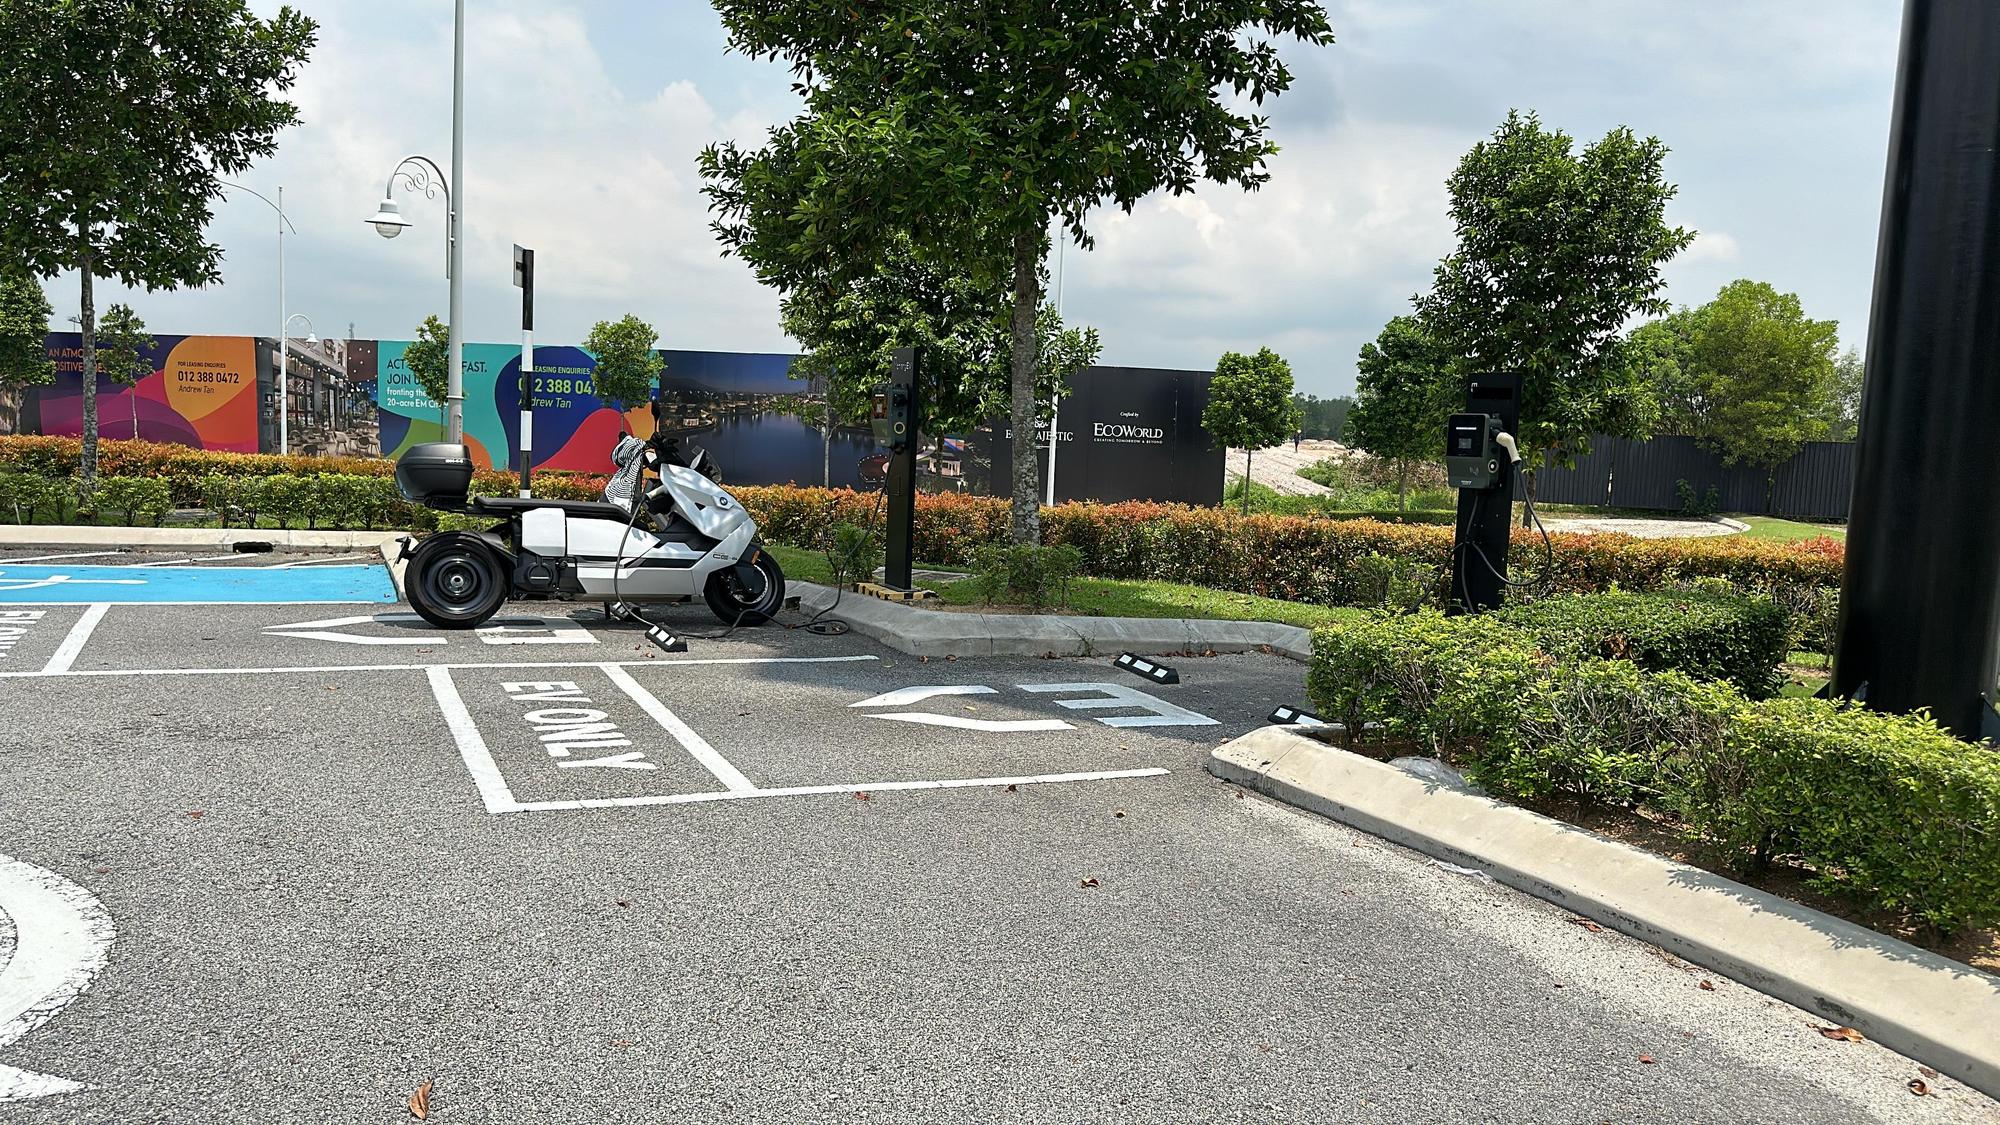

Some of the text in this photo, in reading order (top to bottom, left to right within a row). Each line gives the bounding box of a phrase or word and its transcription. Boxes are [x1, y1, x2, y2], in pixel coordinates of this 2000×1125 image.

[48, 347, 60, 357] AN
[387, 358, 405, 370] ACT
[533, 365, 557, 374] EASING
[557, 366, 591, 375] ENQUIRIES
[178, 371, 240, 384] 012 388 0472
[386, 373, 411, 385] JOIN
[178, 385, 215, 394] Andrew Tan
[386, 386, 427, 398] fronting the
[546, 378, 572, 394] 388
[387, 398, 415, 408] 20-acre
[415, 398, 428, 408] EM
[555, 397, 572, 409] Tan
[499, 680, 658, 770] EV ONLY
